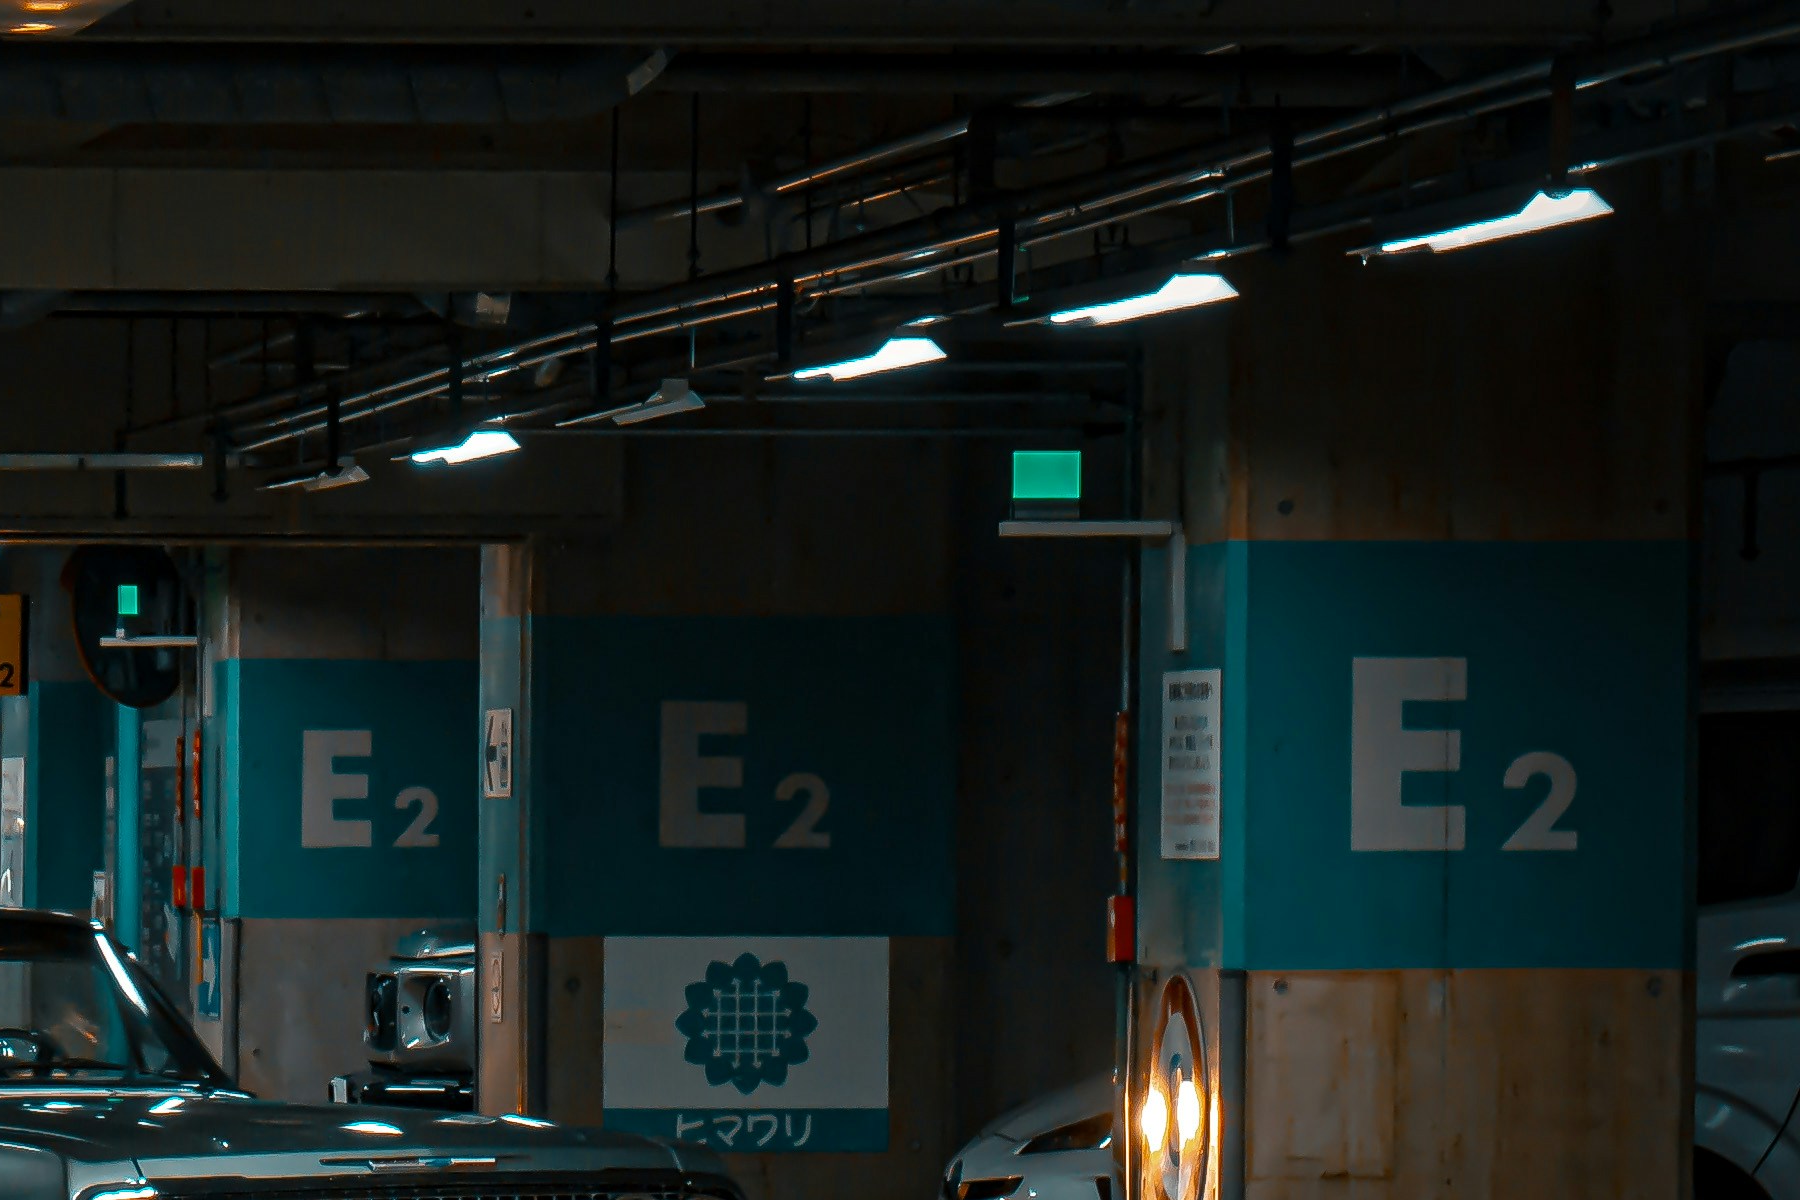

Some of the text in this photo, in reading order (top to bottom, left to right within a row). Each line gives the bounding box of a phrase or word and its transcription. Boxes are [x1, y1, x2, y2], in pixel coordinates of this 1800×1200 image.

[301, 729, 441, 848] E2
[658, 699, 831, 849] E2
[1351, 656, 1578, 853] E2
[676, 1113, 812, 1147] ヒマワリ
